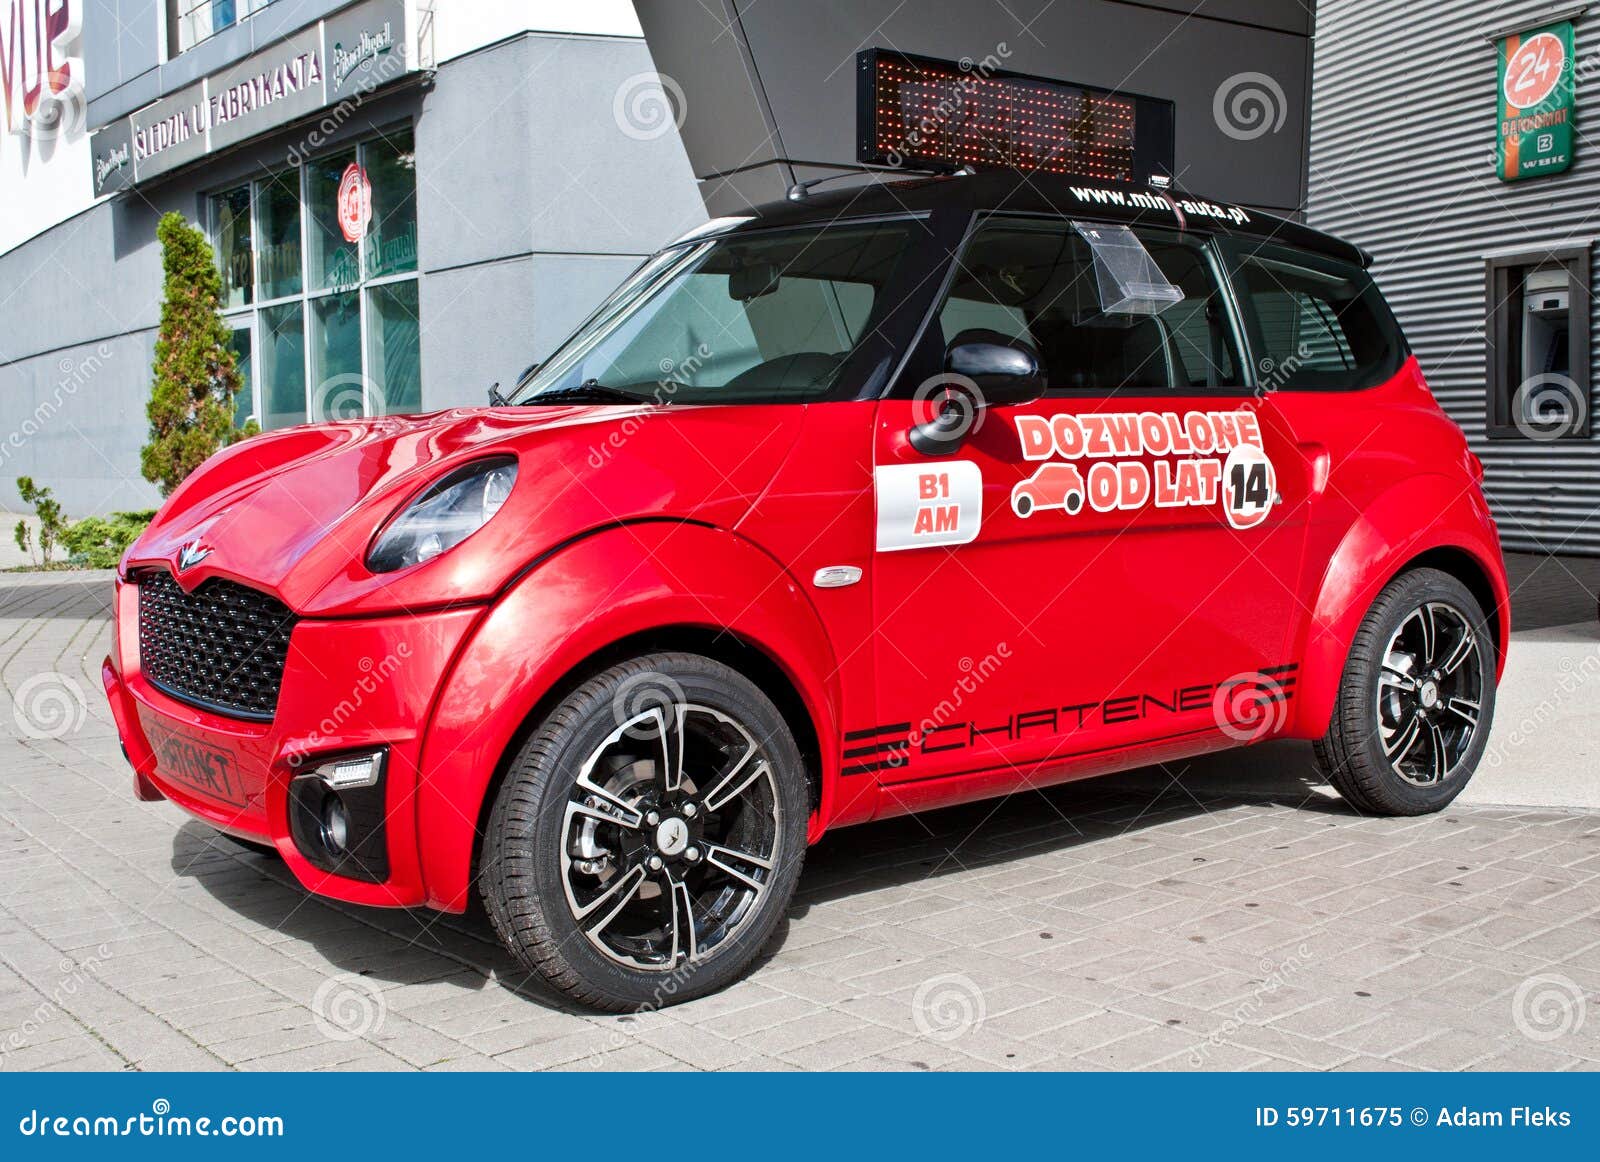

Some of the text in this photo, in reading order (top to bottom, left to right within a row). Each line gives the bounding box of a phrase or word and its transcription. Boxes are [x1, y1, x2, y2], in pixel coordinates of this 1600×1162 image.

[193, 101, 206, 135] U
[207, 49, 322, 130] FABRYKANTA
[1515, 47, 1550, 92] 24
[1502, 108, 1567, 136] BANKOMAT
[1069, 186, 1251, 225] www.min-auta.pl
[1014, 411, 1263, 460] DOZWOLONE
[918, 474, 949, 500] B1
[1088, 459, 1268, 512] OD LAT 14
[913, 506, 958, 535] AM
[920, 679, 1248, 754] CHATENET
